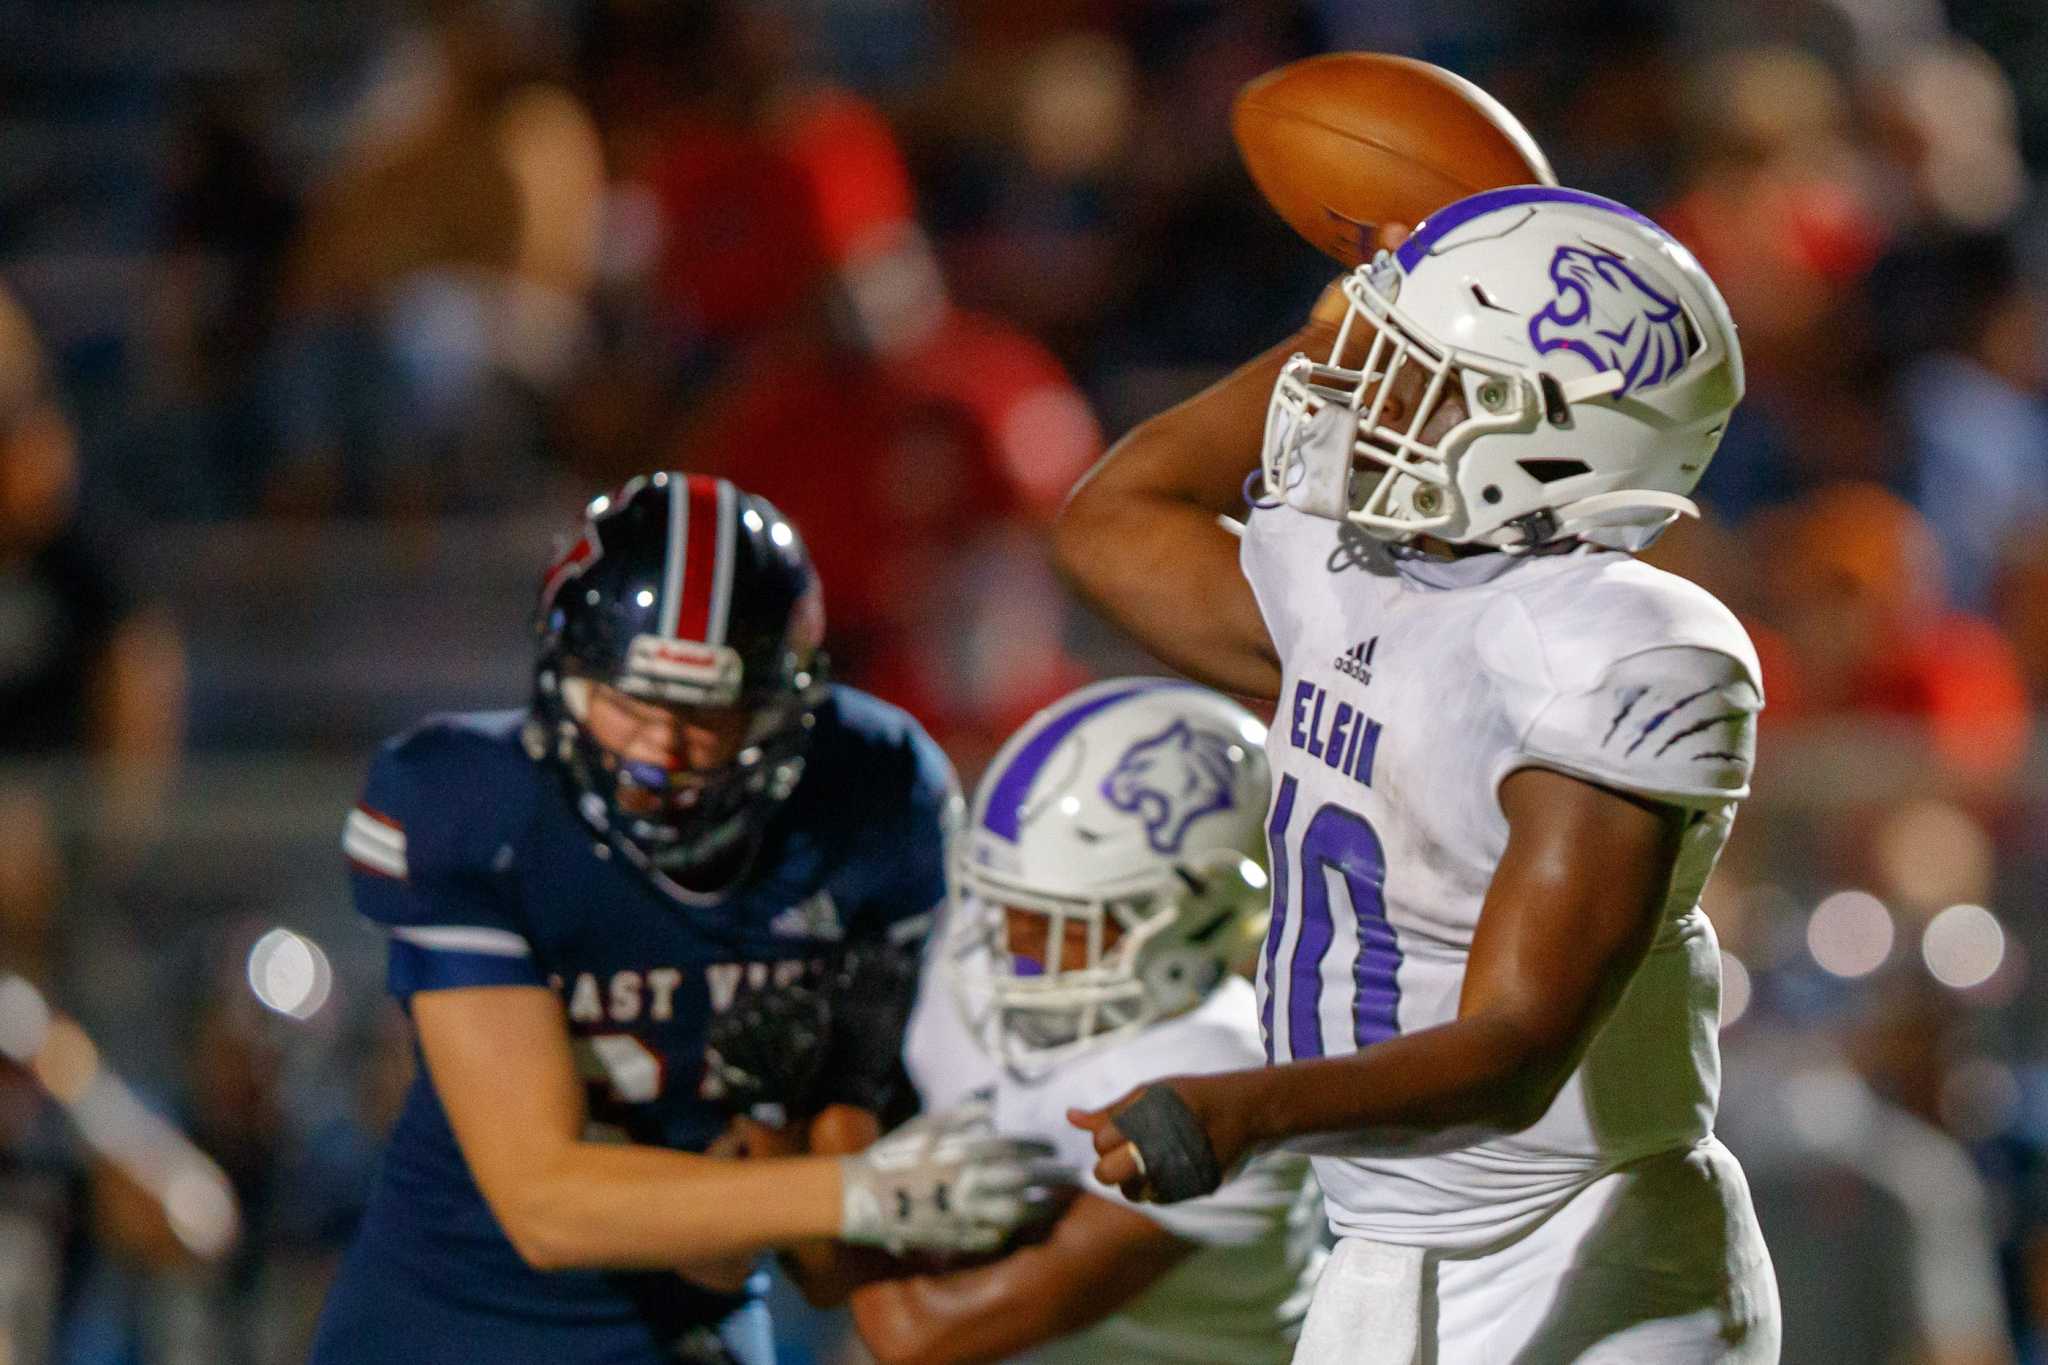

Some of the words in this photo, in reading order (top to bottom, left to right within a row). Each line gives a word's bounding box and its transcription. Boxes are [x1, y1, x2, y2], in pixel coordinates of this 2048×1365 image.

[1334, 656, 1372, 686] adidas
[1290, 680, 1383, 788] ELGIN
[1261, 771, 1404, 1065] 10
[548, 969, 684, 1023] AST
